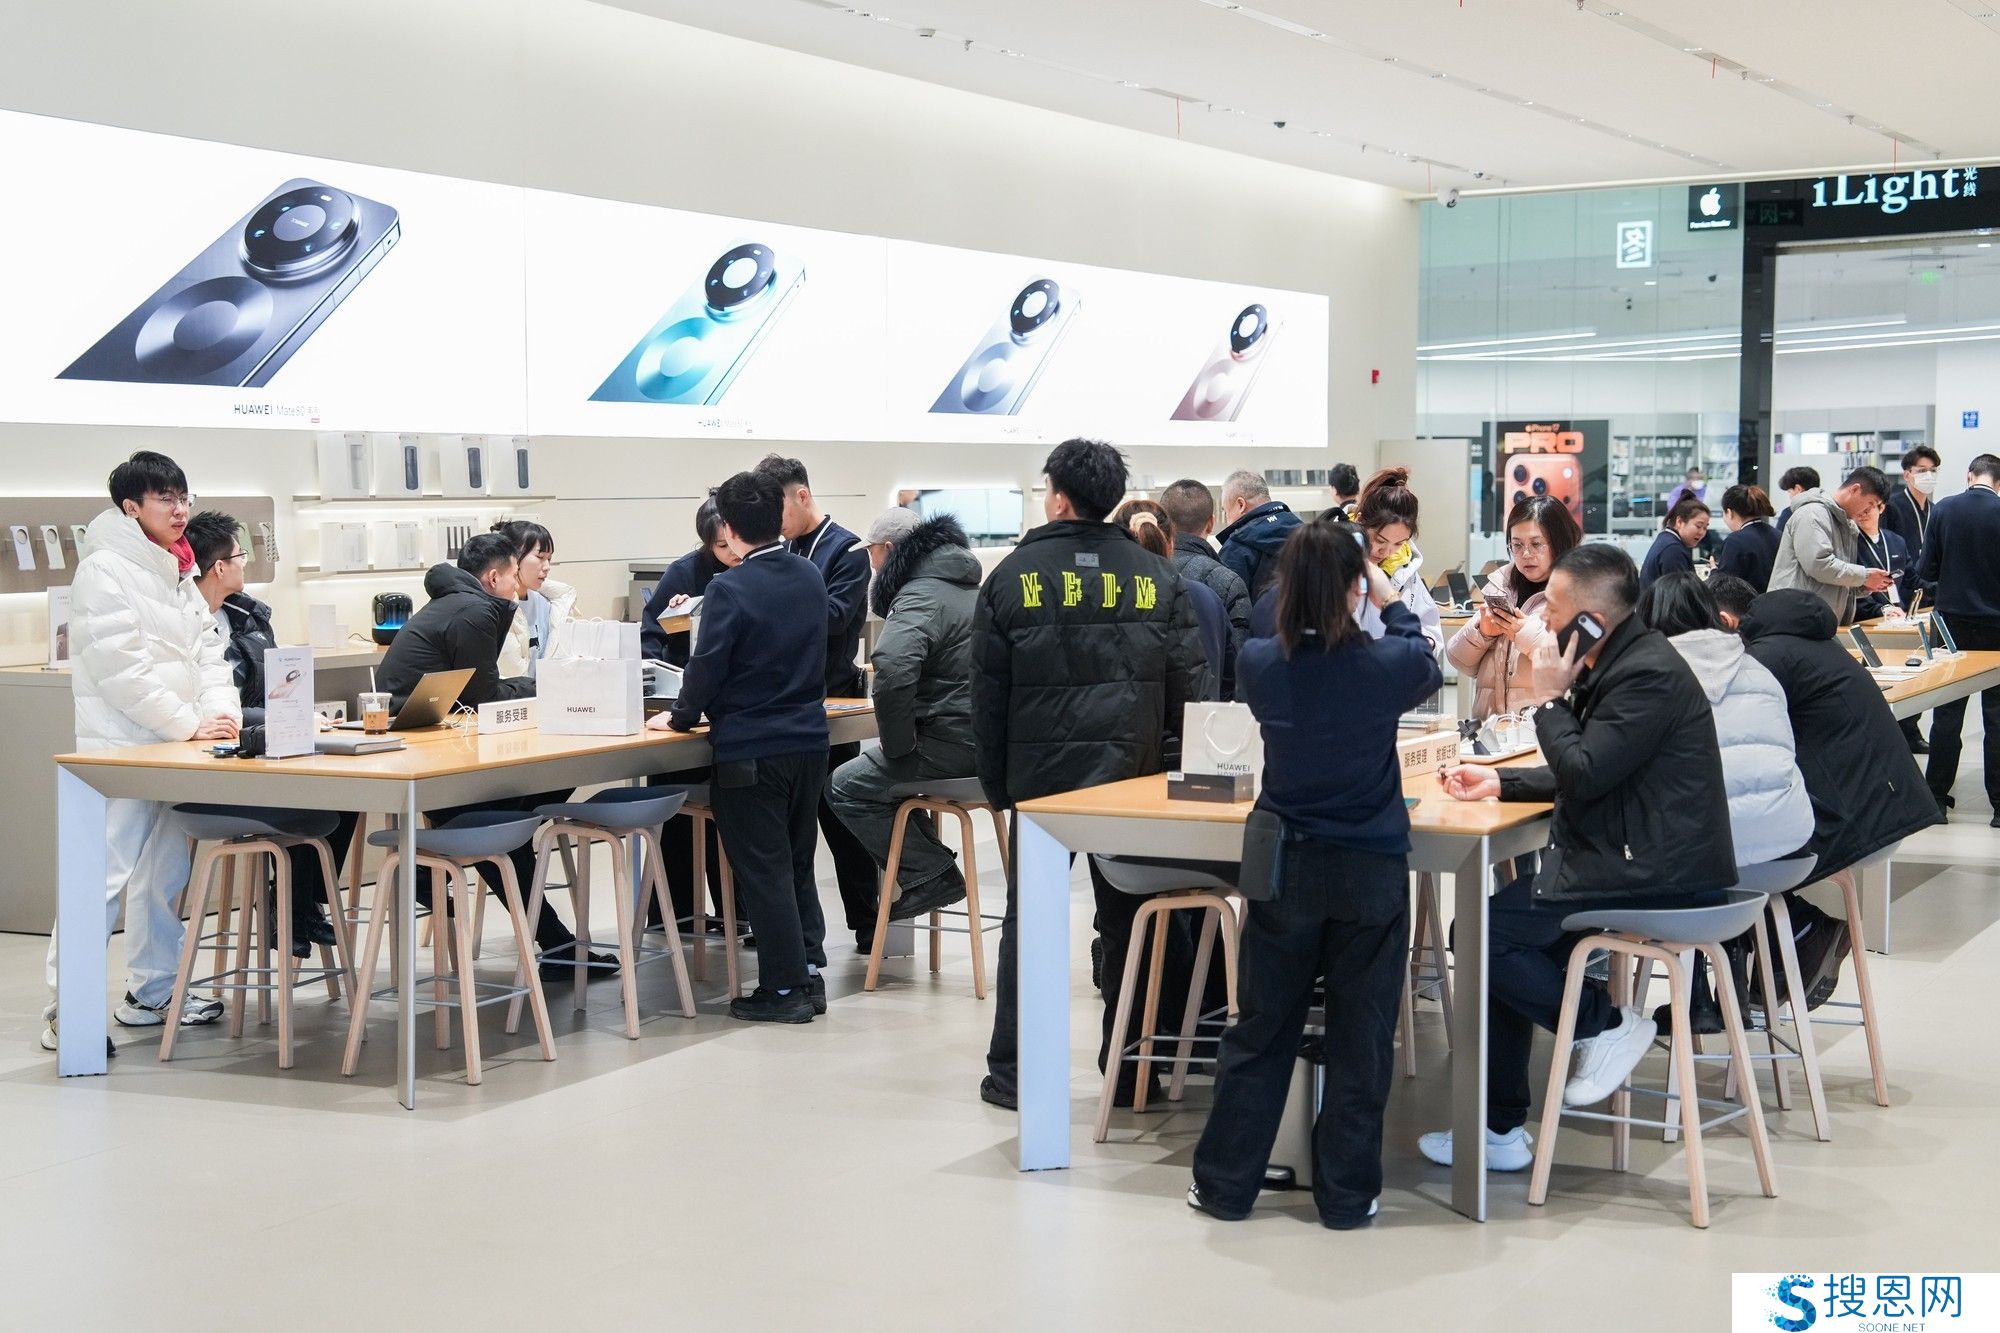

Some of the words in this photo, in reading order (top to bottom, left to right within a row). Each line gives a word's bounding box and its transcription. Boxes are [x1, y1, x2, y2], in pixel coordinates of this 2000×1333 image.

[1812, 168, 1960, 214] iLight
[234, 404, 273, 415] HUAWEI
[1504, 431, 1584, 454] PRO
[496, 707, 528, 724] 服务受理
[1217, 763, 1251, 772] HUAWEI
